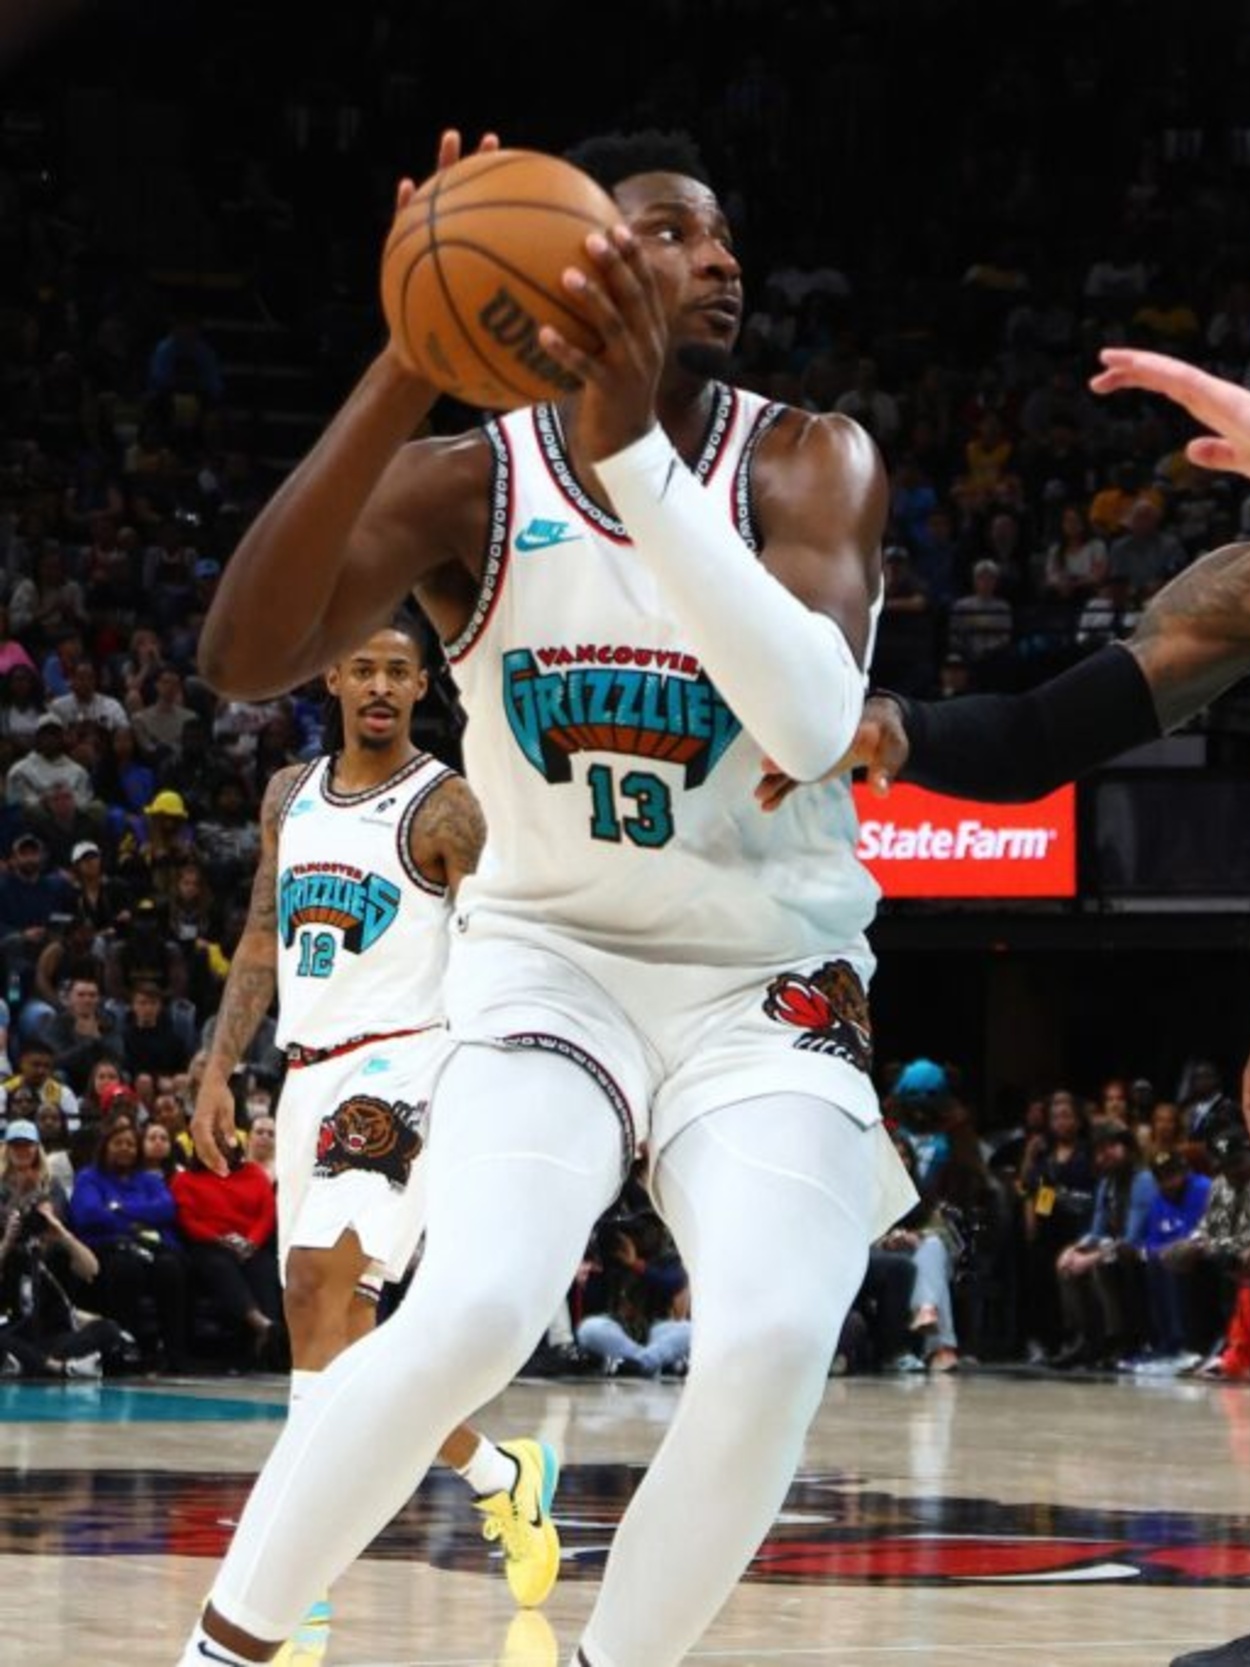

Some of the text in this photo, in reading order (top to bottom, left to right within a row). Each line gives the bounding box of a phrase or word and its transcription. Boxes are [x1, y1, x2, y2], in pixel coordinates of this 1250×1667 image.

[537, 644, 700, 675] VANCOUVER
[586, 763, 675, 850] 13
[279, 866, 402, 956] GRIZZLIES
[296, 930, 337, 979] 12
